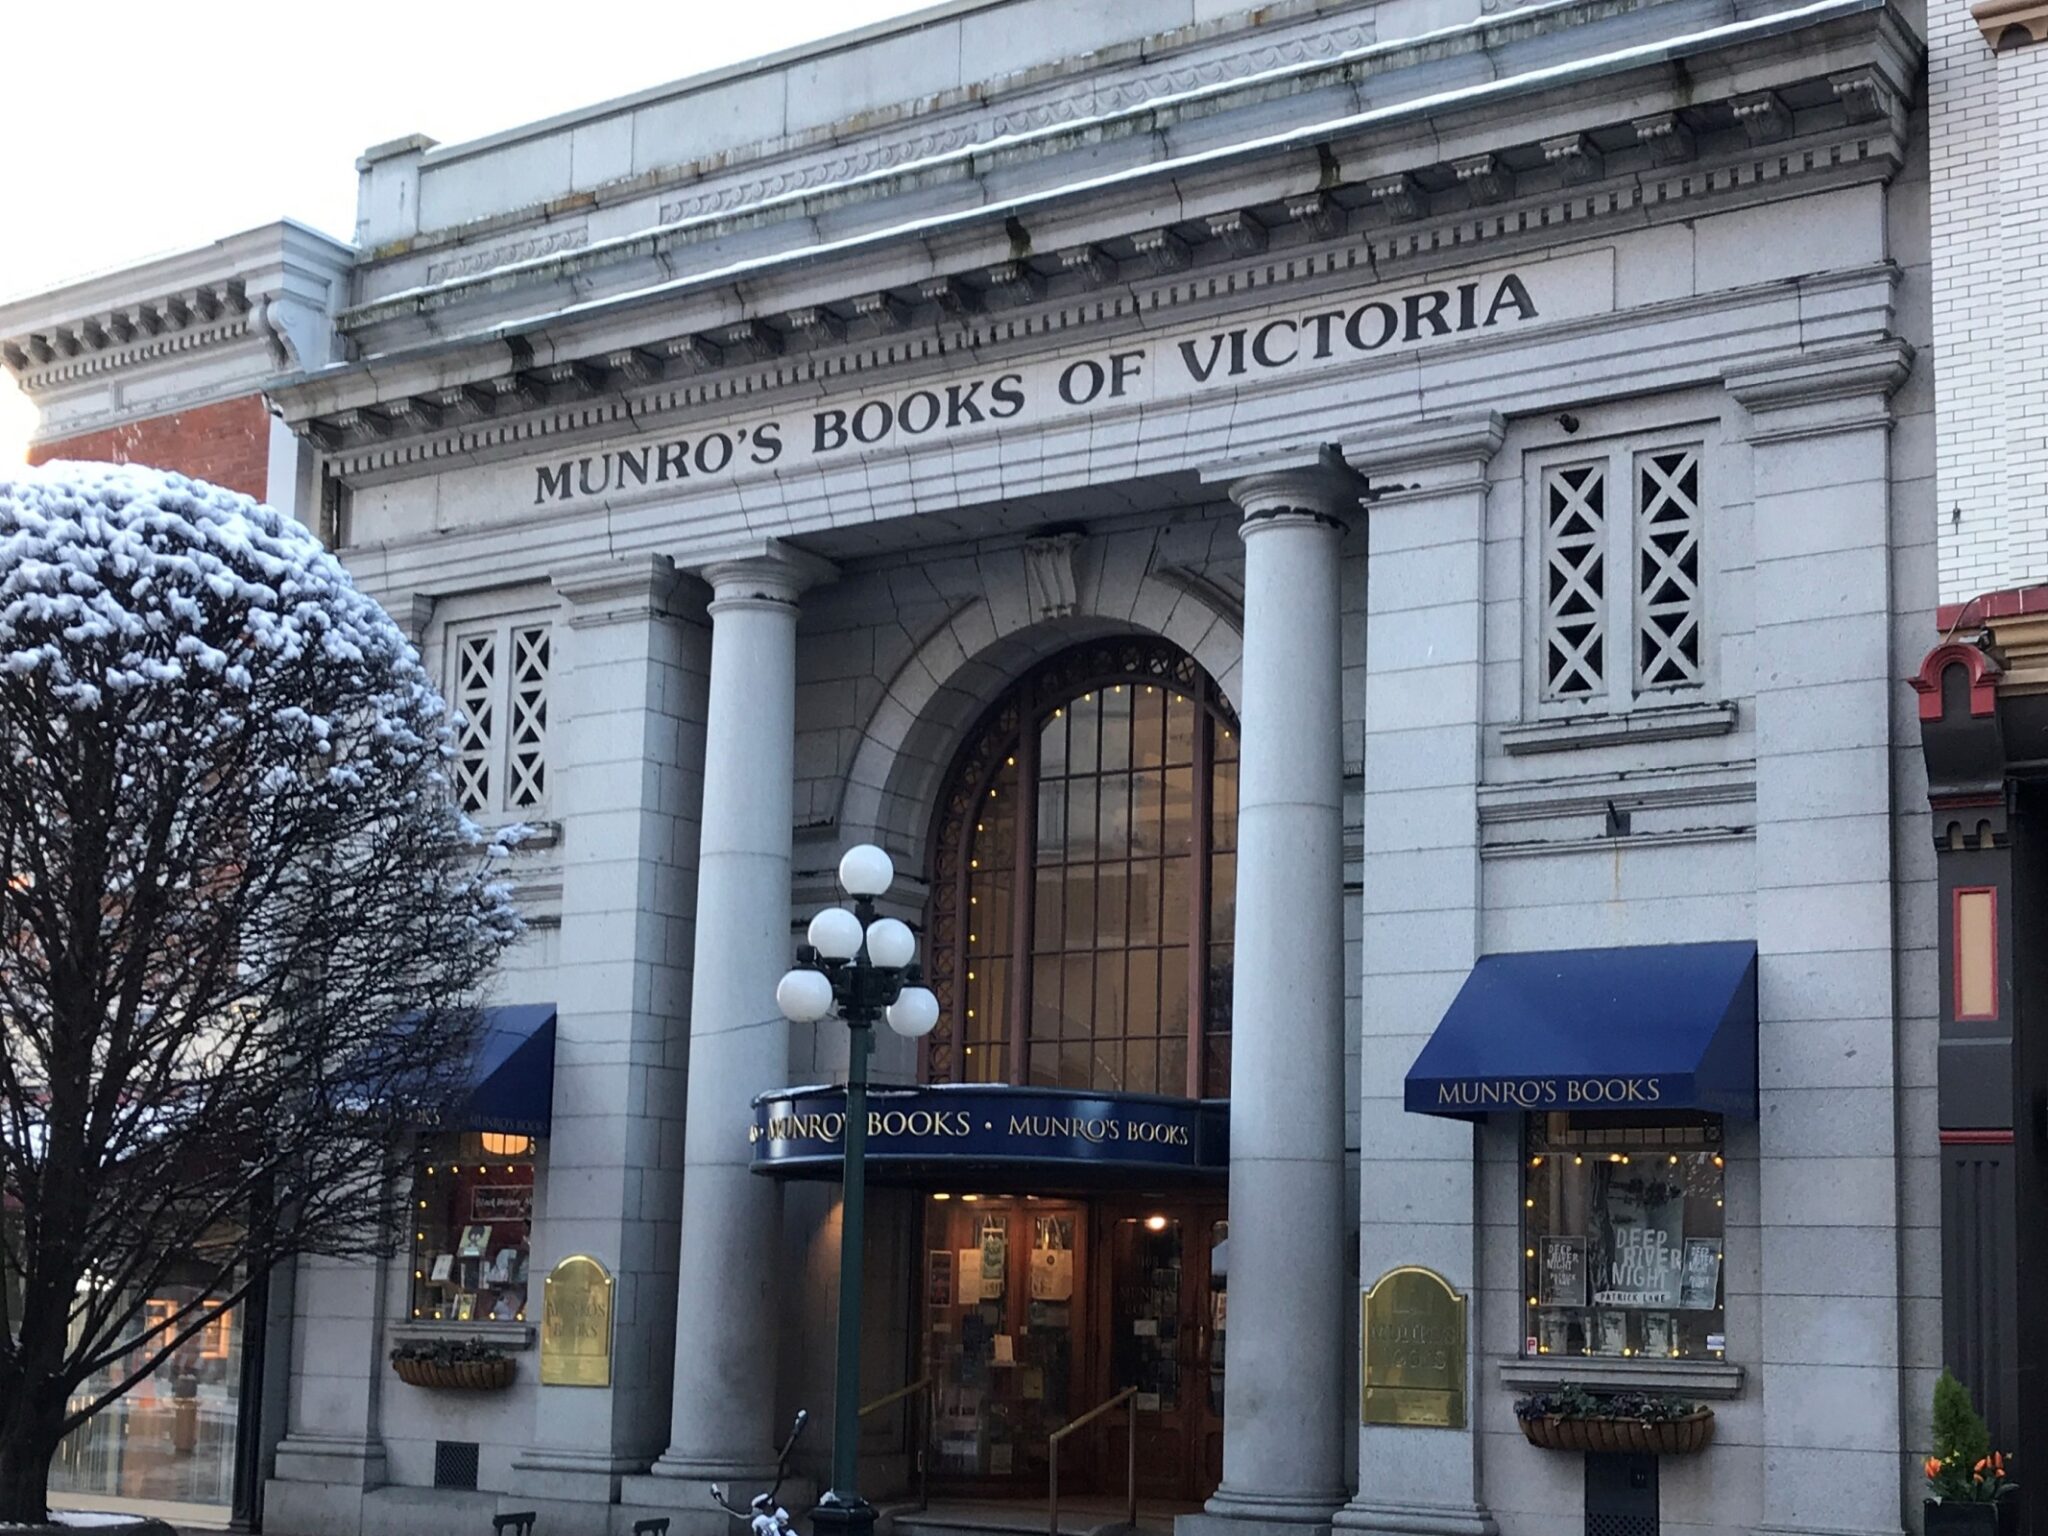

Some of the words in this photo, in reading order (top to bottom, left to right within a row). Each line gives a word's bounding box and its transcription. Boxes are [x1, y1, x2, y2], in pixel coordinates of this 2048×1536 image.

[533, 422, 782, 505] MUNRO'S
[811, 373, 1025, 454] BOOKS
[1057, 349, 1147, 405] OF
[1177, 273, 1540, 383] VICTORIA
[1438, 1080, 1557, 1107] MUNRO'S
[1567, 1078, 1661, 1102] BOOKS
[767, 1111, 846, 1143] MUNRO'
[867, 1110, 971, 1137] BOOKS
[1008, 1115, 1120, 1143] MUNRO'S
[1127, 1122, 1189, 1146] BOOKS
[1616, 1227, 1668, 1249] DEEP
[1623, 1246, 1682, 1270] RIVER
[1612, 1261, 1669, 1289] NIGHT
